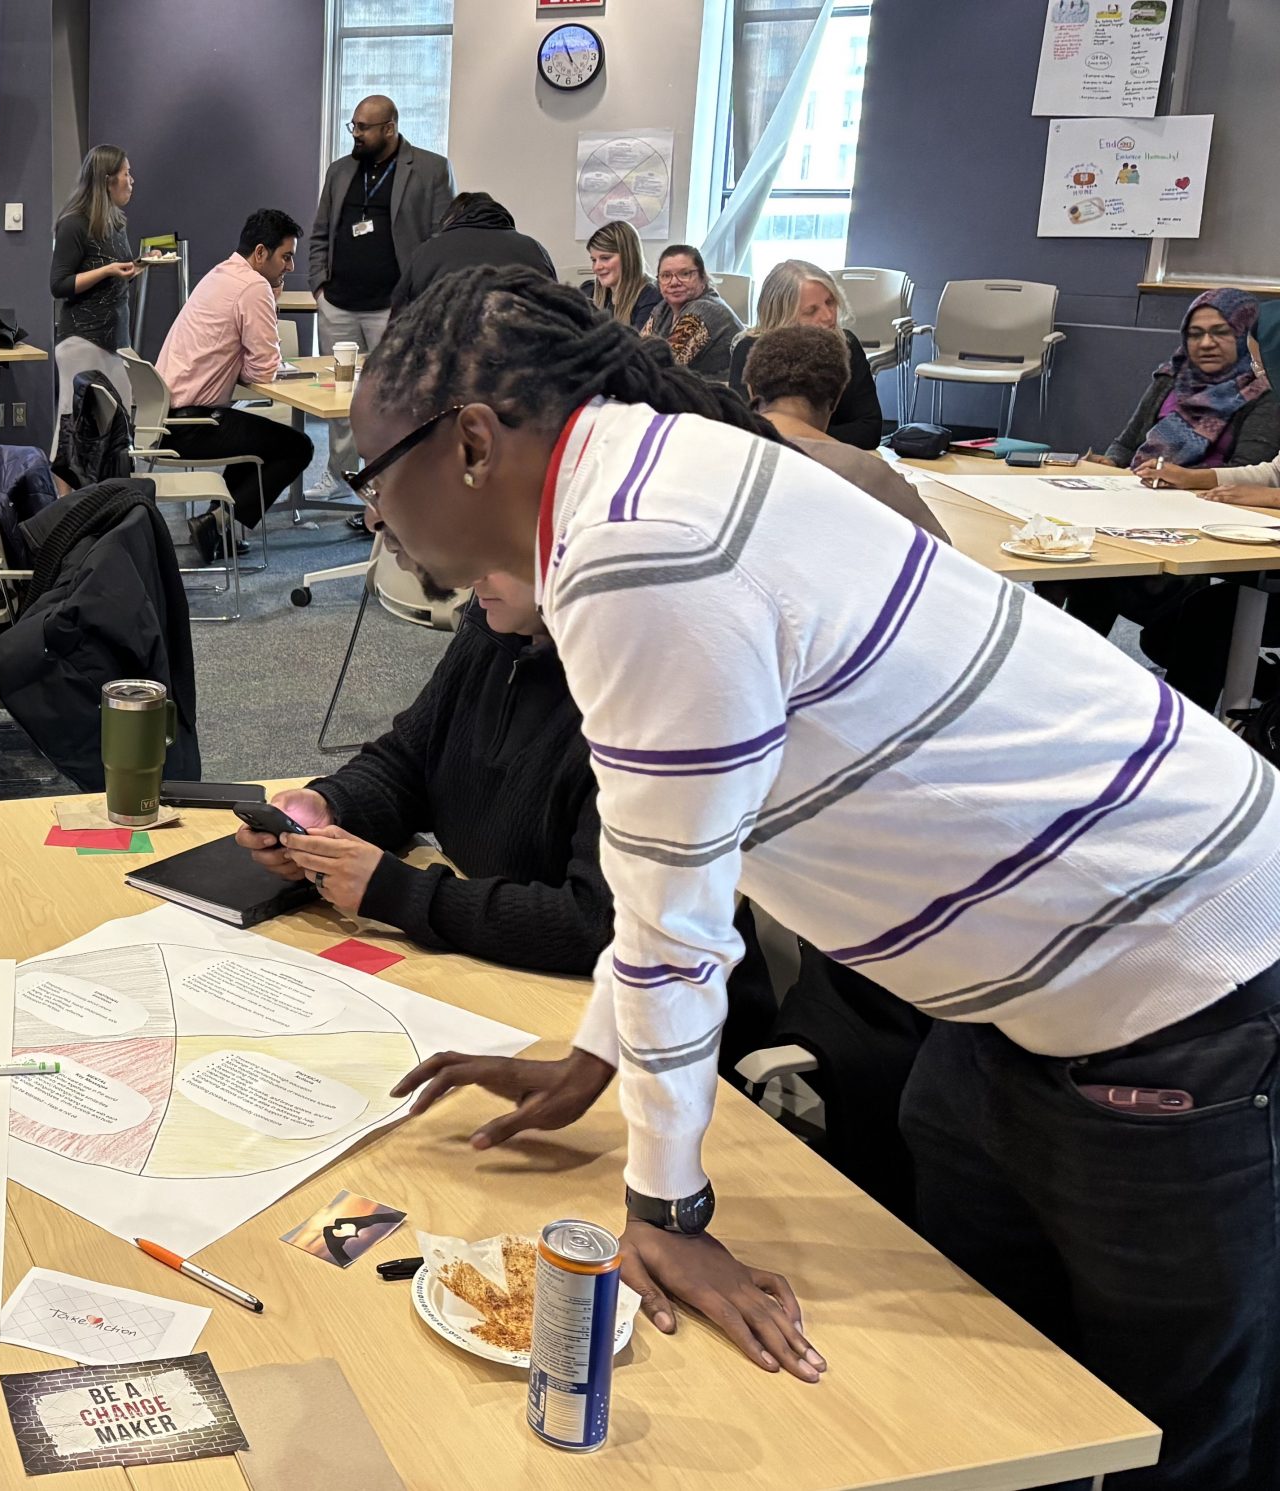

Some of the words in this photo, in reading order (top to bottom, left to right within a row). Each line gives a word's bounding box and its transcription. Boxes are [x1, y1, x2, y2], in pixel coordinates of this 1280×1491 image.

[86, 1074, 106, 1084] MENTAL
[296, 1071, 321, 1083] PHYSICAL
[50, 1308, 86, 1324] Take
[95, 1322, 137, 1336] Action
[88, 1385, 121, 1405] BE
[125, 1382, 142, 1399] A
[79, 1395, 172, 1427] CHANGE
[94, 1415, 178, 1445] MAKER
